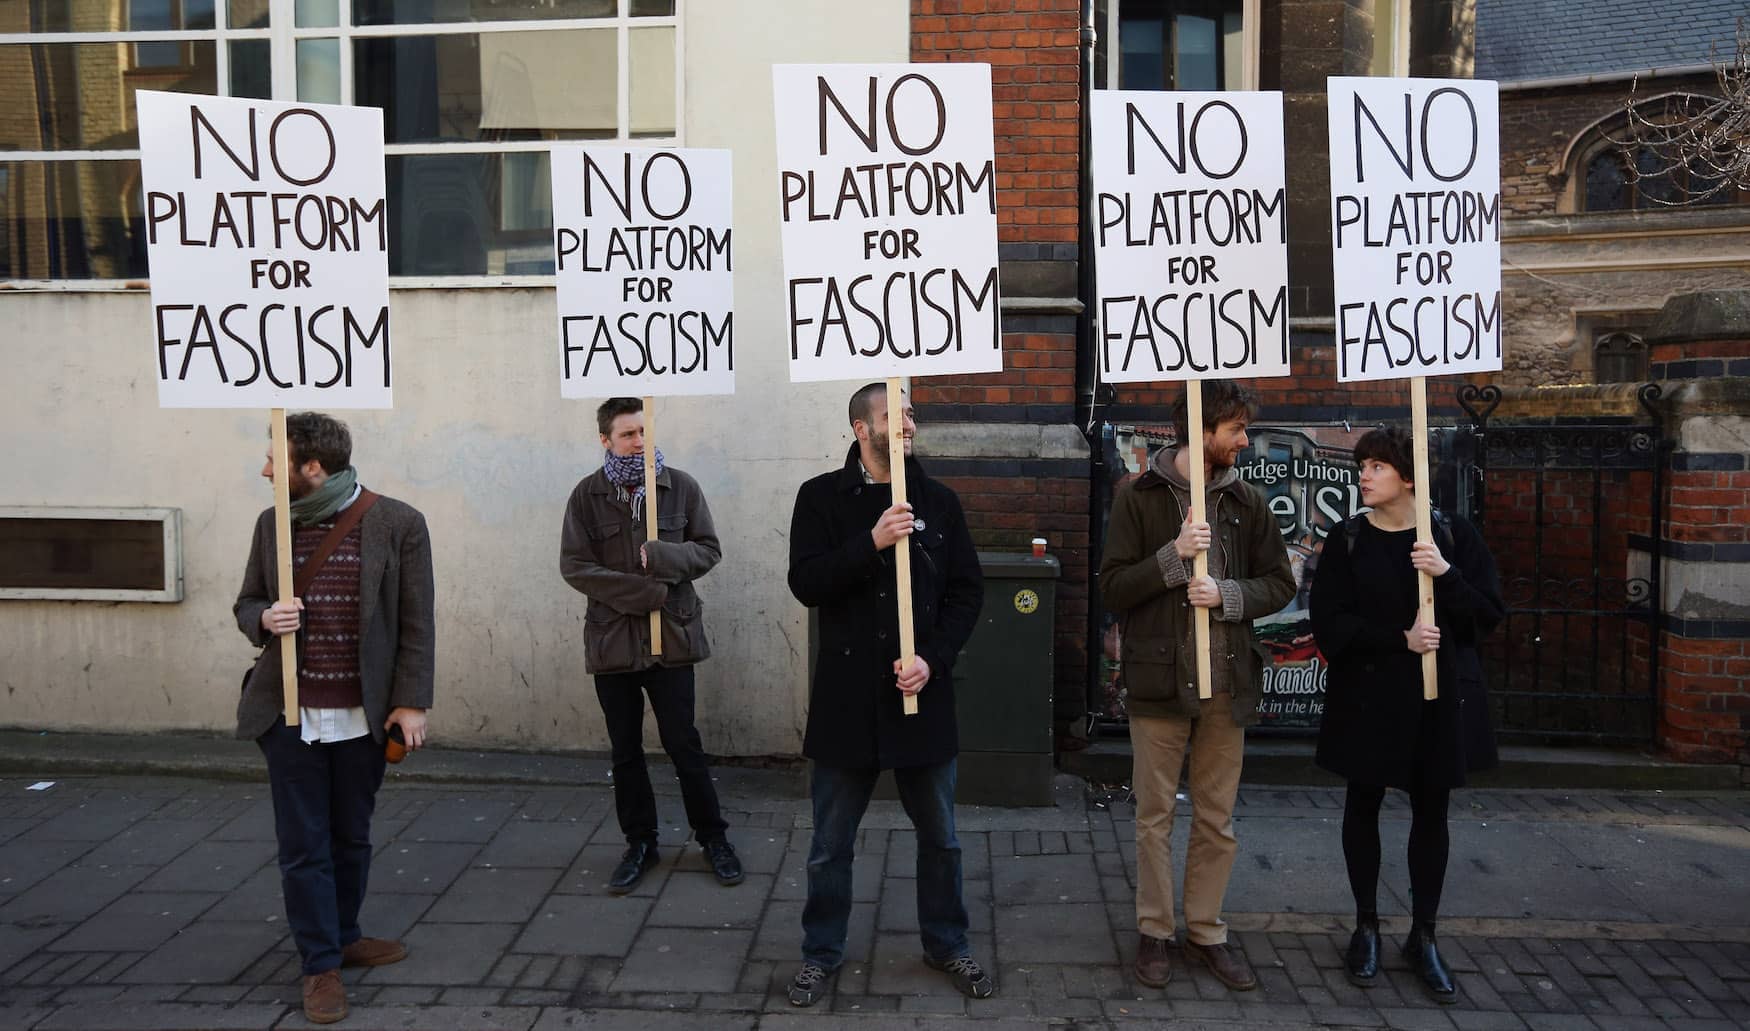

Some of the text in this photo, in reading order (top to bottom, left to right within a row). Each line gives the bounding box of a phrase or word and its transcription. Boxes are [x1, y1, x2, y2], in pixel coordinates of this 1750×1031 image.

[818, 74, 946, 155] NO
[1127, 101, 1248, 179] NO
[1354, 88, 1478, 183] NO
[191, 106, 336, 186] NO
[584, 152, 692, 223] NO
[782, 161, 996, 221] PLATFORM
[148, 192, 386, 251] PLATFORM
[864, 229, 922, 259] FOR
[1099, 188, 1286, 247] PLATFORM
[1337, 191, 1500, 248] PLATFORM
[251, 260, 313, 289] FOR
[558, 225, 732, 272] PLATFORM
[1168, 256, 1220, 285] FOR
[1397, 251, 1453, 285] FOR
[624, 277, 673, 302] FOR
[790, 267, 999, 360] FASCISM
[156, 304, 390, 388] FASCISM
[563, 311, 733, 379] FASCISM
[1102, 286, 1288, 372] FASCISM
[1340, 291, 1501, 377] FASCISM
[1294, 460, 1352, 484] Union
[1274, 657, 1319, 694] and
[1285, 698, 1306, 714] the
